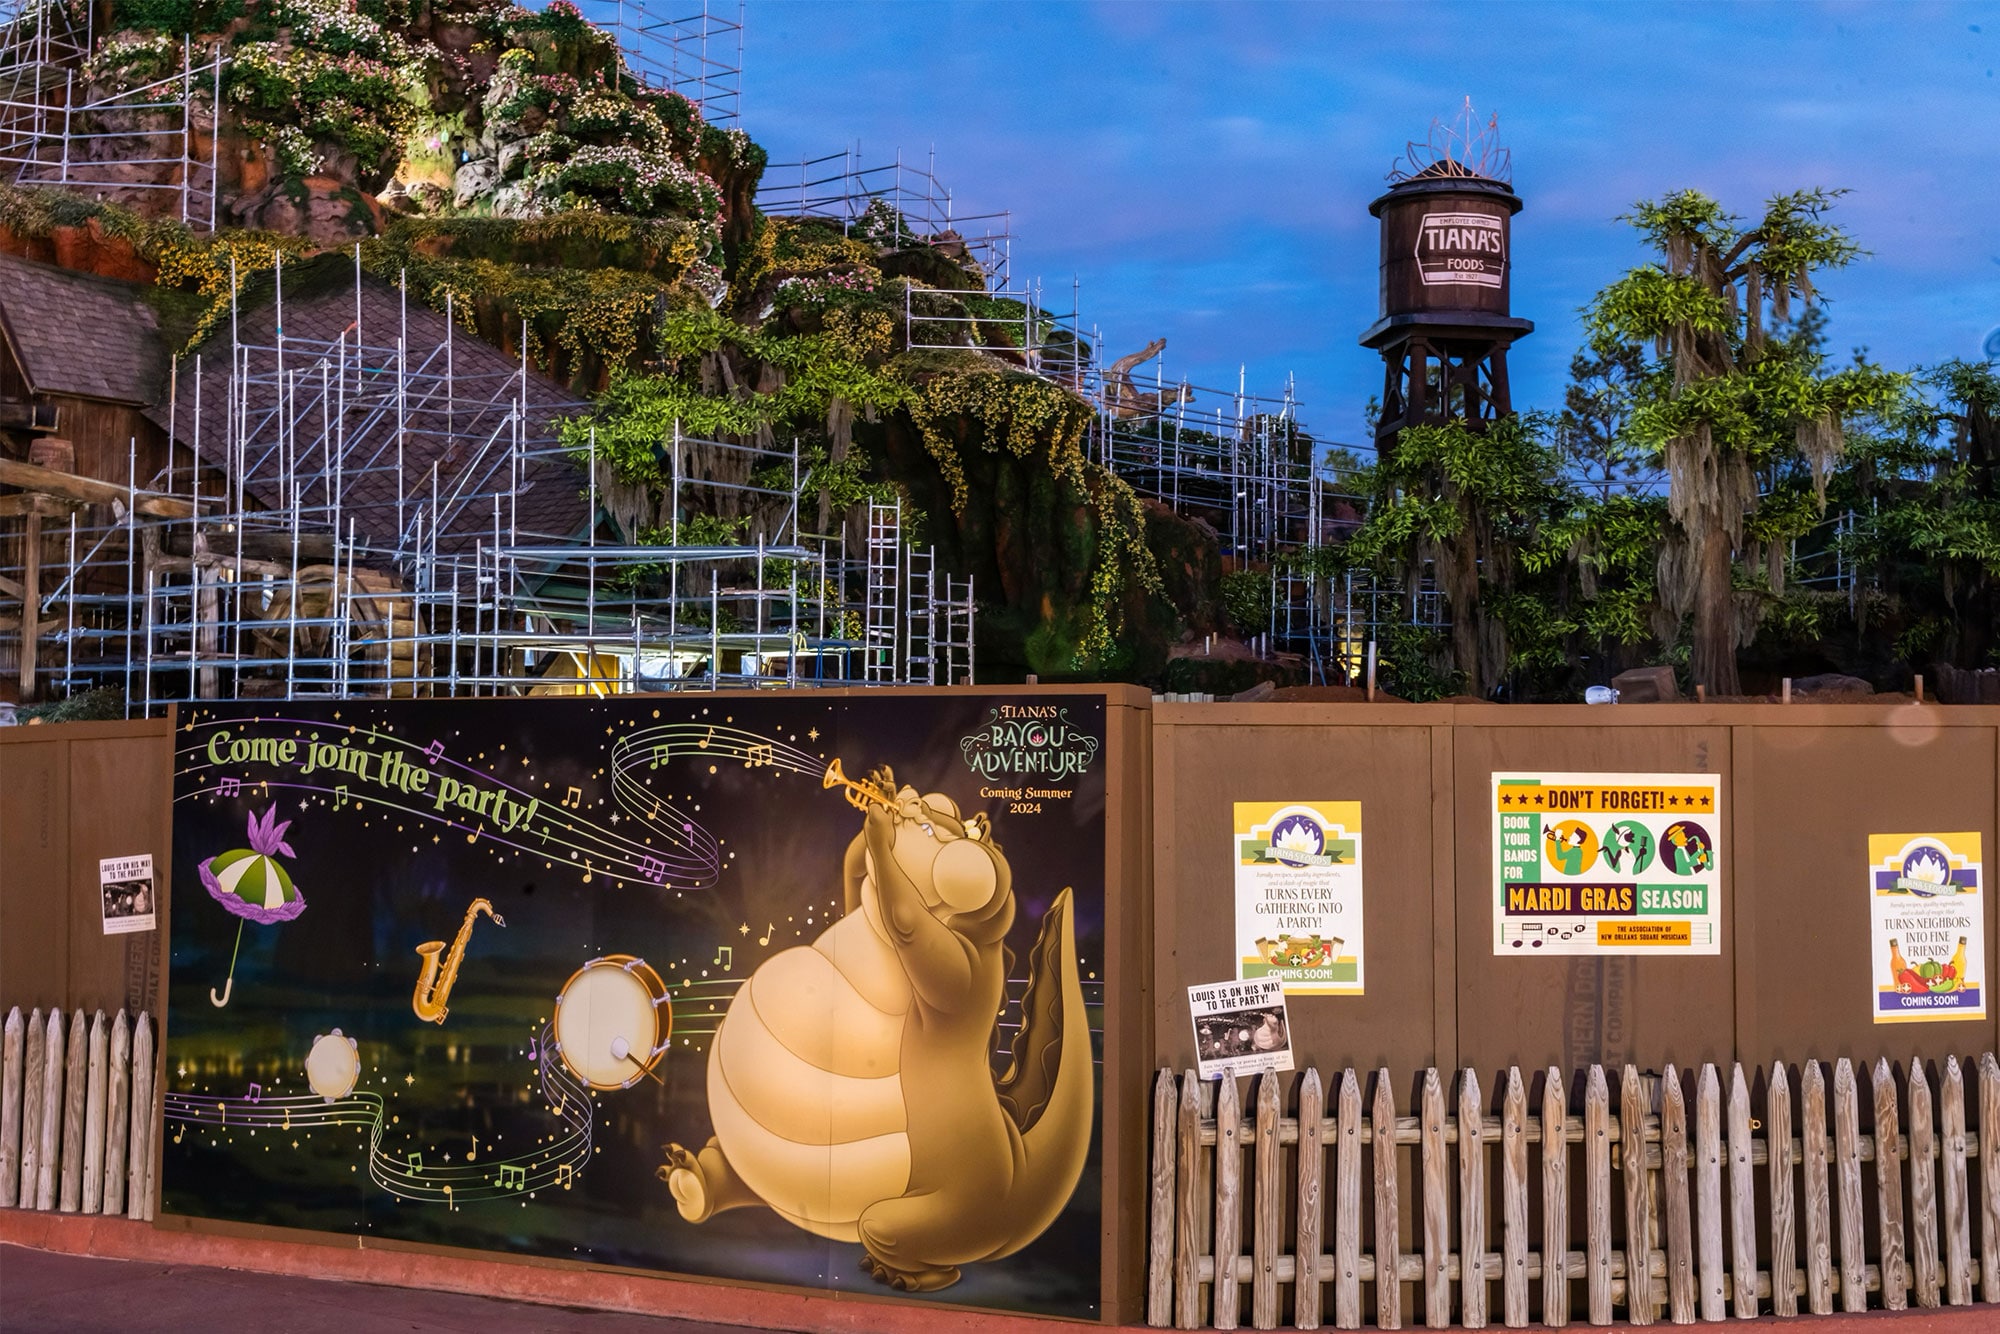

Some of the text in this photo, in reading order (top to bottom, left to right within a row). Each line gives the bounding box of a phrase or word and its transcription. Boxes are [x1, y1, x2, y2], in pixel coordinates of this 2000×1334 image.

[1425, 228, 1500, 253] TIANA'S
[1447, 258, 1484, 271] FOODS
[1000, 705, 1057, 718] TIANA'S
[991, 721, 1065, 747] BAYOU
[970, 748, 1087, 781] ADVENTURE
[207, 730, 539, 833] Come join the party!
[980, 787, 1072, 800] Coming Summer
[1548, 790, 1664, 809] DON'T FORGET!
[1010, 803, 1042, 814] 2024
[1503, 816, 1530, 829] BOOK
[1504, 833, 1530, 846] YOUR
[1504, 849, 1537, 863] BANDS
[1504, 866, 1523, 879] FOR
[1264, 888, 1333, 900] TURNS EVERY
[1509, 887, 1702, 911] MARDI GRAS SEASON
[1256, 903, 1343, 914] GATHERING INTO
[1276, 917, 1322, 929] A PARTY!
[1885, 916, 1971, 930] TURNS NEIGHBORS
[1906, 931, 1950, 944] INTO FINE
[1908, 945, 1949, 957] FRIENDS!
[1267, 968, 1333, 979] COMING SOON!
[1191, 982, 1281, 1002] LOUIS IS ON HIS WAY
[1206, 994, 1269, 1011] TO THE PARTY!
[1901, 994, 1959, 1007] COMING SOON!
[1572, 1001, 1595, 1068] THERN
